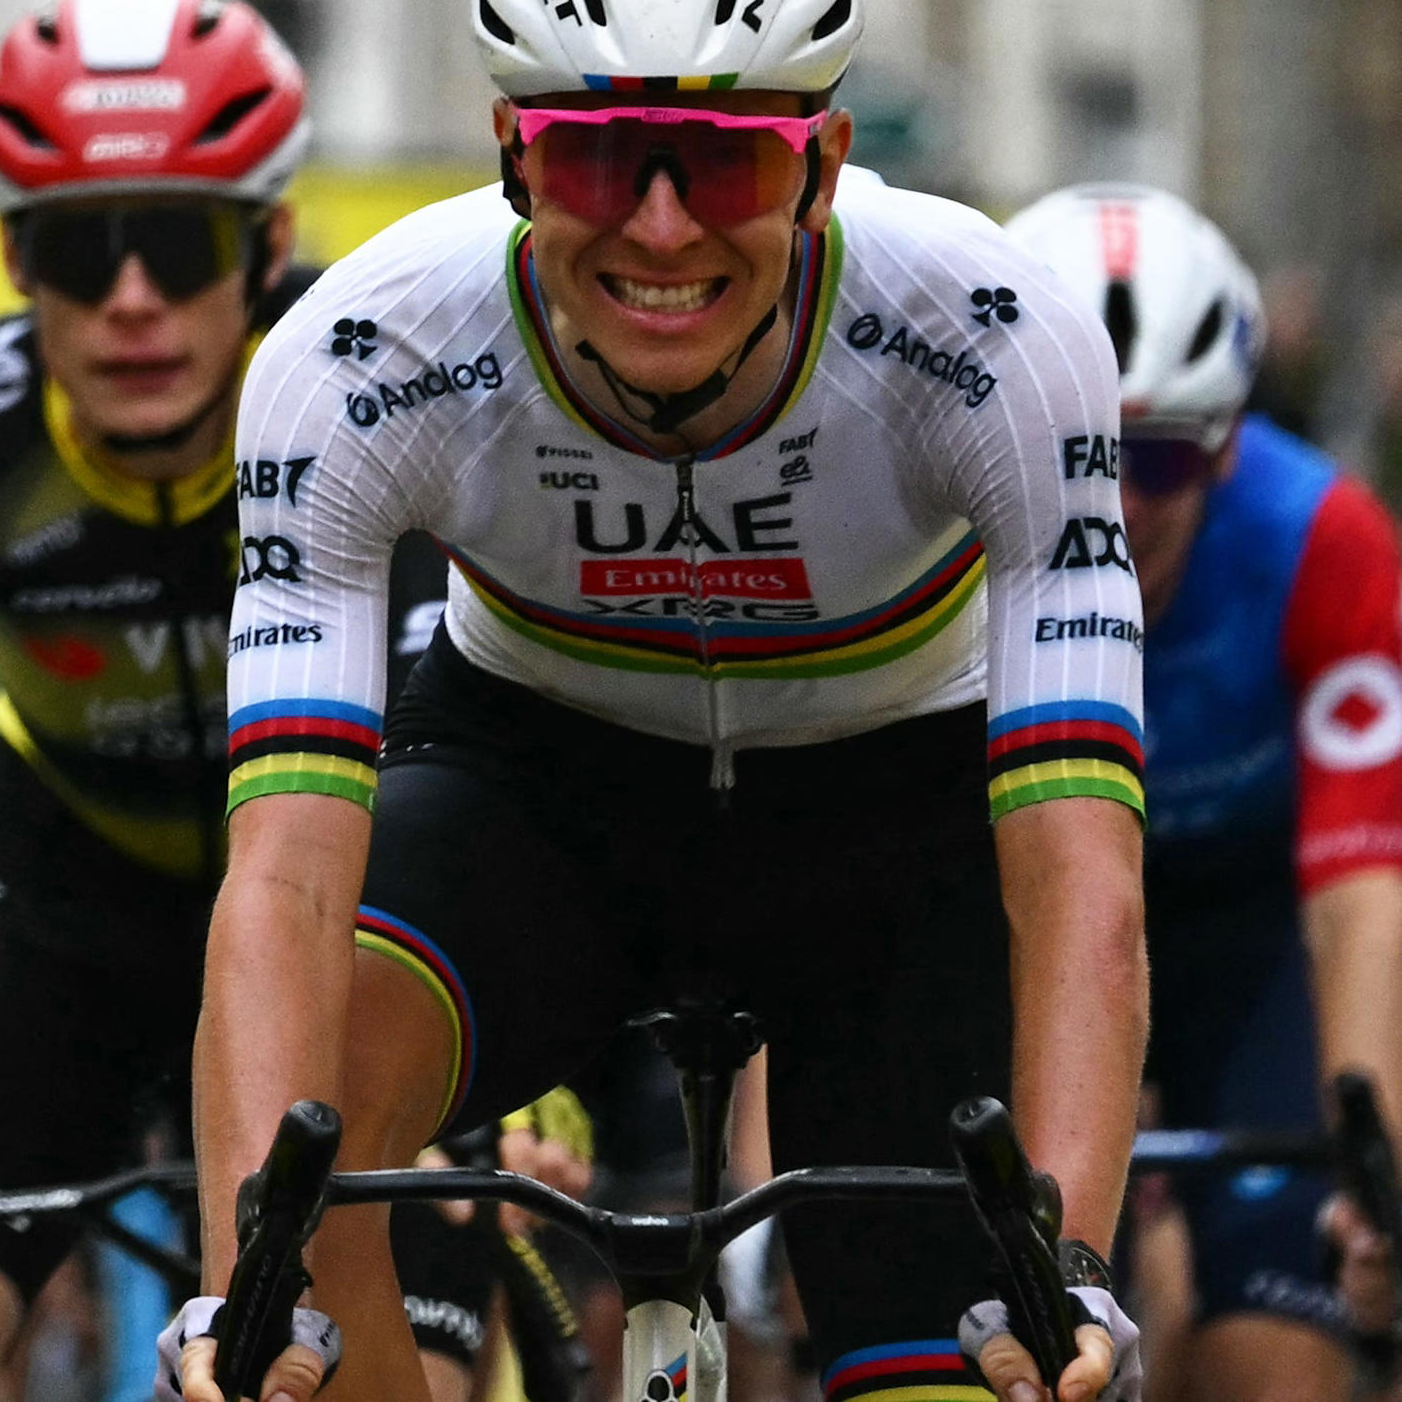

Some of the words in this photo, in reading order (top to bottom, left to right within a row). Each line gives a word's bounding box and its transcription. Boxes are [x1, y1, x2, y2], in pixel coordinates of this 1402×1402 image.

[379, 351, 504, 416] Analog
[881, 326, 998, 408] Analog
[574, 492, 800, 554] UAE
[240, 534, 302, 587] DQ
[604, 567, 789, 592] Emirates
[580, 597, 821, 623] XRG
